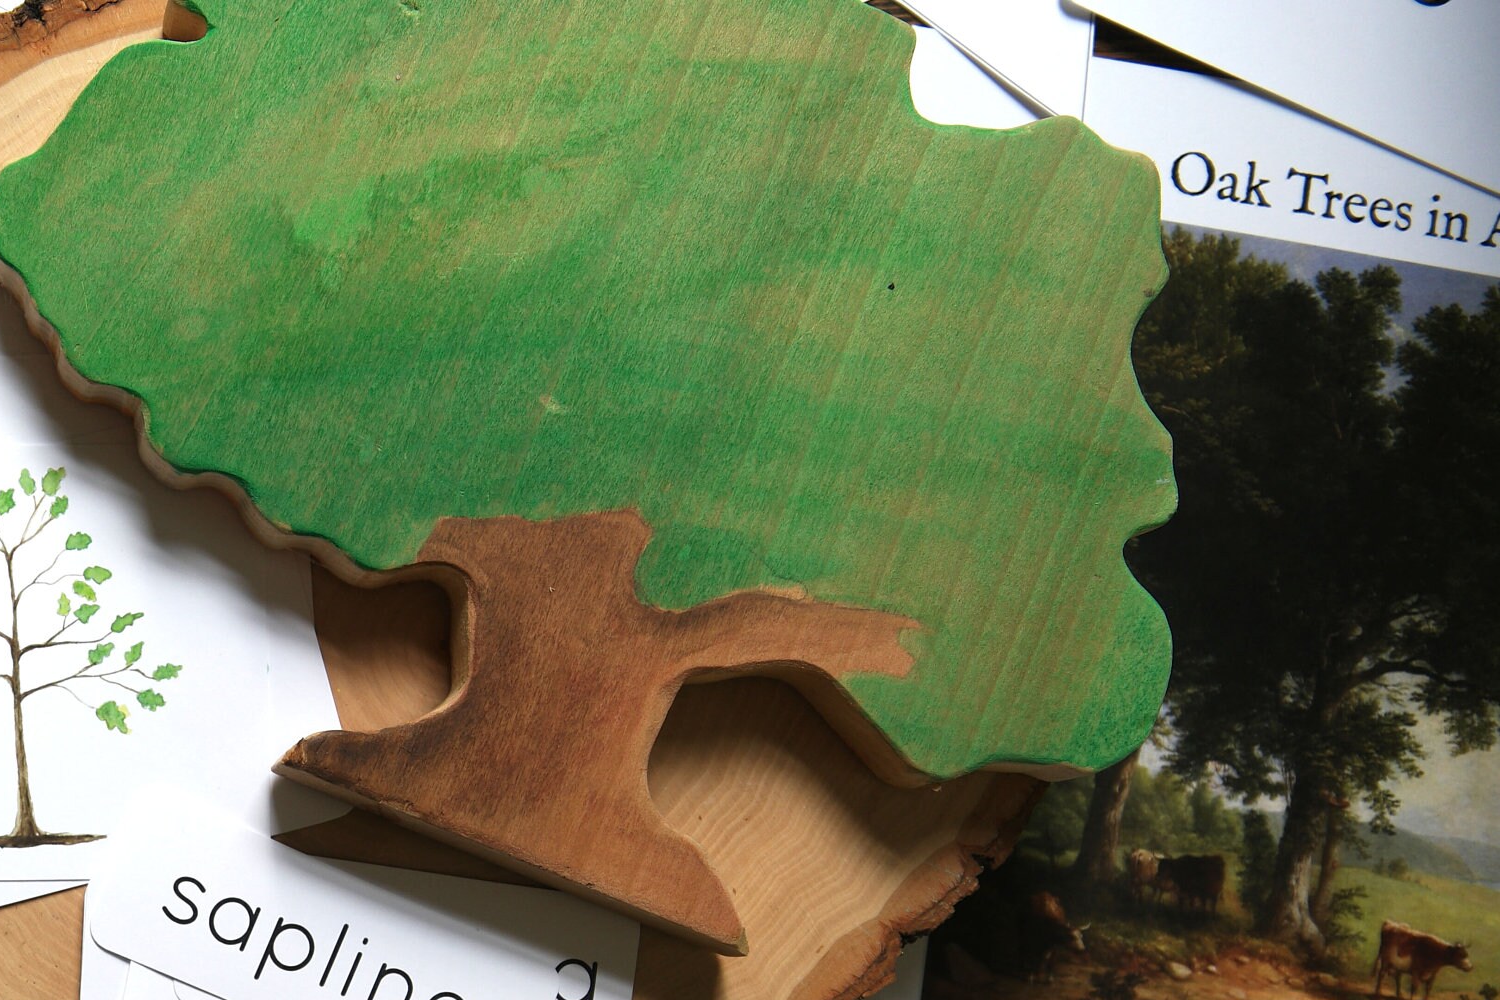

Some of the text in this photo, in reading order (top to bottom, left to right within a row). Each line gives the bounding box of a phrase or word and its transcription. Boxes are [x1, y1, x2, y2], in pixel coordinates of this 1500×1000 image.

[1170, 151, 1272, 208] Oak
[1287, 167, 1412, 232] Trees
[1425, 194, 1468, 242] in
